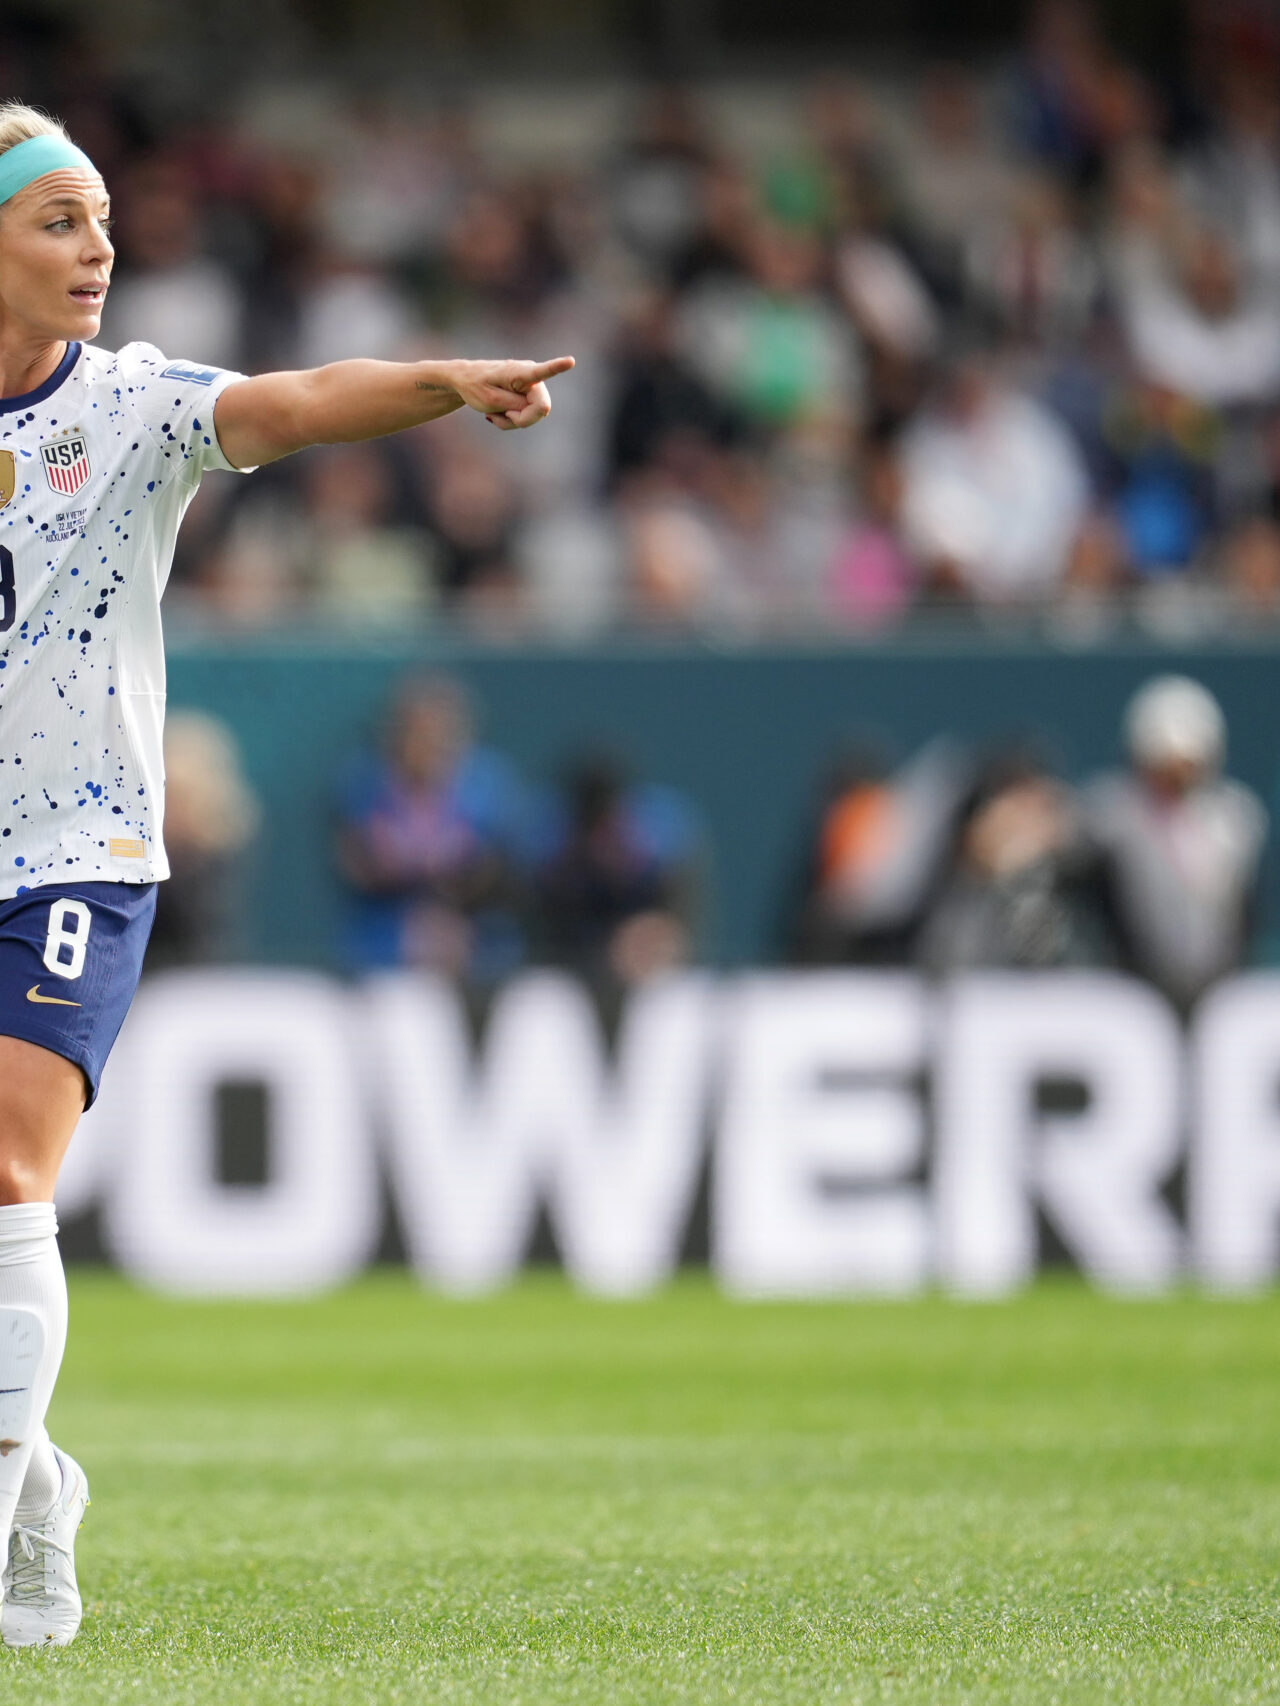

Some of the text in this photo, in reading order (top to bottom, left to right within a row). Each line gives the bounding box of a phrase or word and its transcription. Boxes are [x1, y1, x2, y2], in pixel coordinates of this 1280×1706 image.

[44, 441, 83, 466] USA
[56, 513, 65, 521] USA
[43, 898, 92, 980] 8
